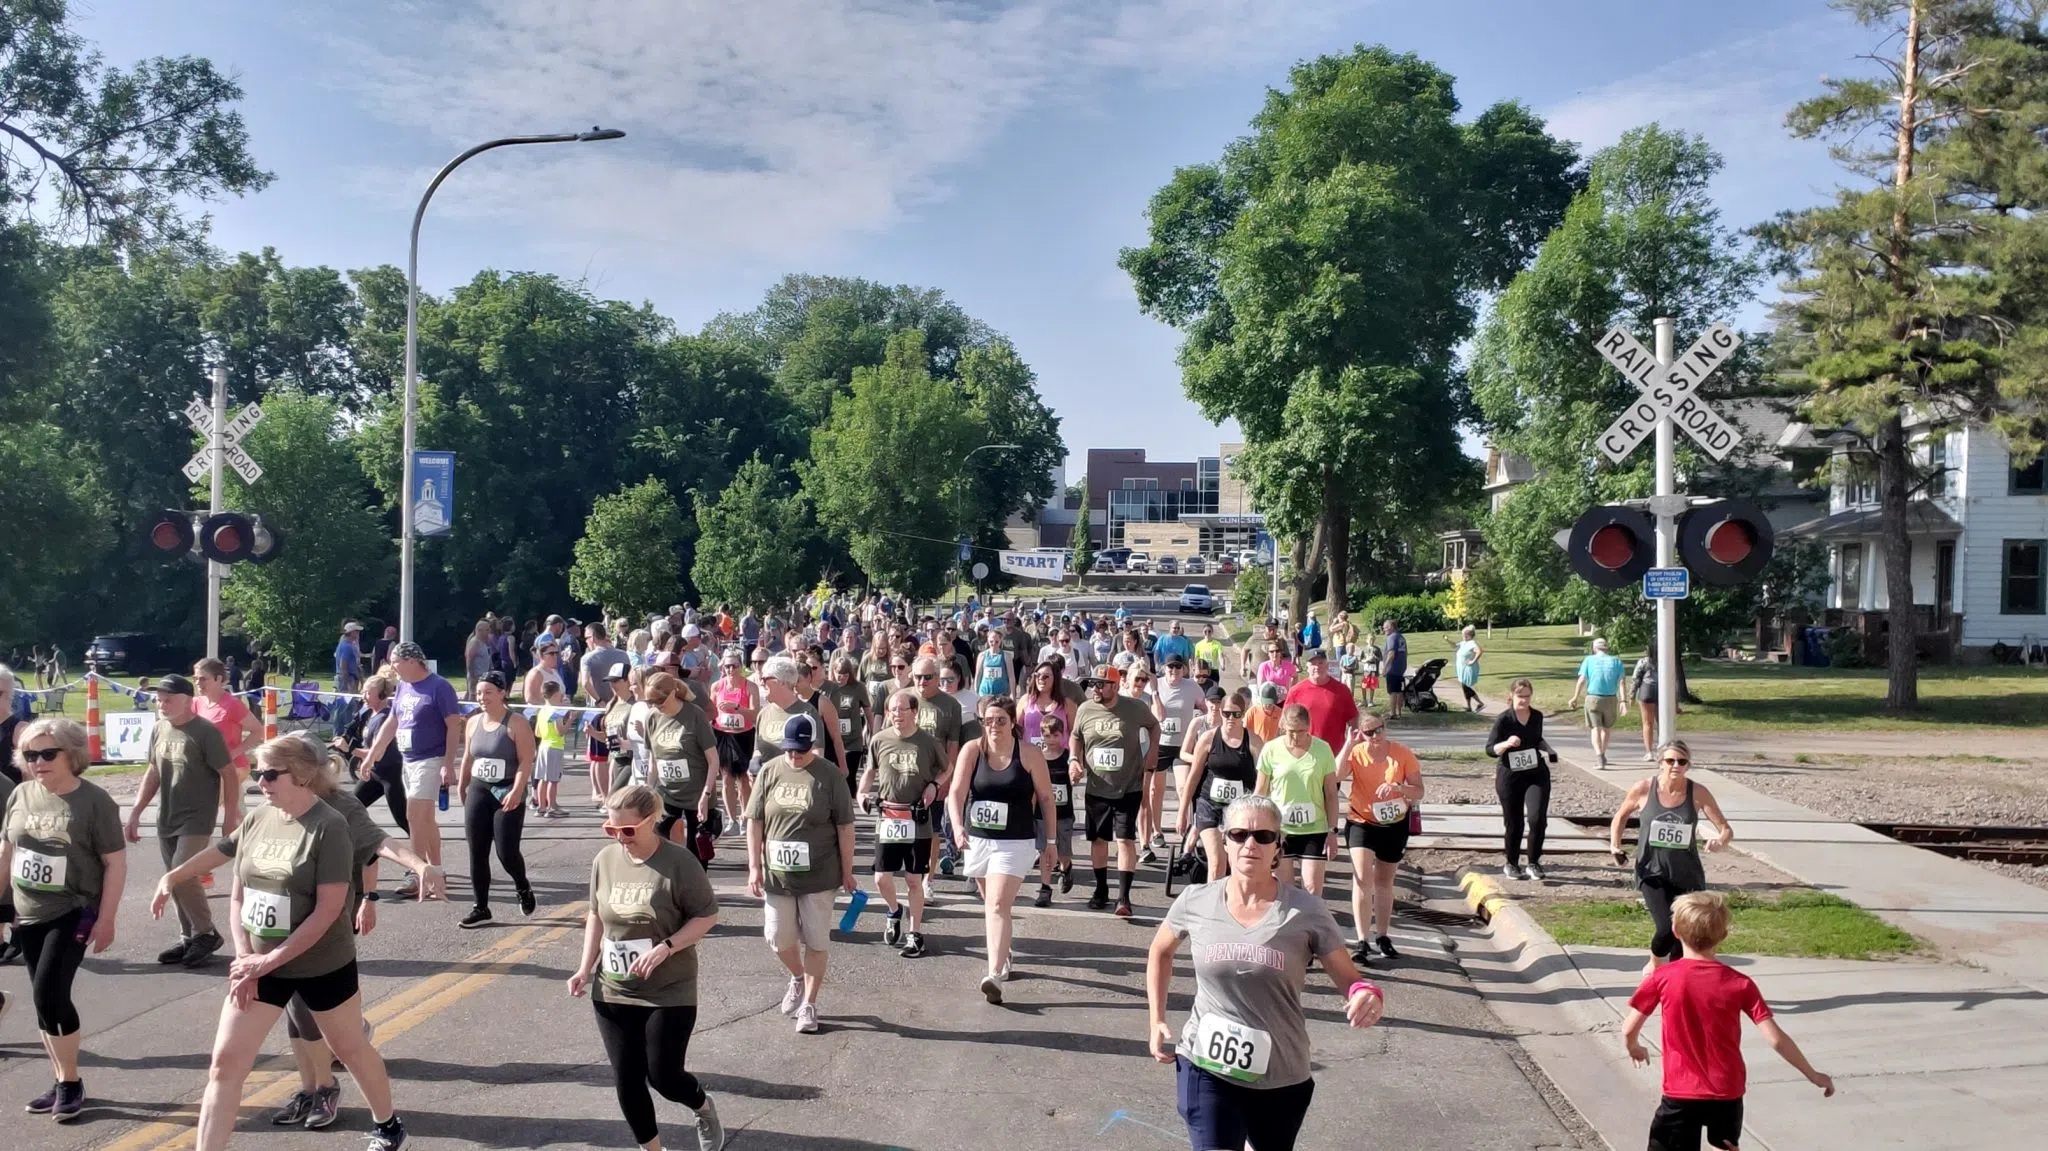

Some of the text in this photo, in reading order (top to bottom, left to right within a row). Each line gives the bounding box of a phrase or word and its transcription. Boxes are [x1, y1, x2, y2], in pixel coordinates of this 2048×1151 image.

[1603, 331, 1731, 451] RAIL ROAD
[1605, 328, 1733, 455] CROSSING
[187, 406, 260, 478] CROSING
[227, 447, 258, 480] ROAD
[419, 457, 449, 465] WELCOME
[1006, 555, 1058, 569] START
[119, 717, 142, 726] FINISH
[1098, 754, 1118, 767] 449
[1514, 754, 1533, 767] 364
[662, 766, 683, 779] 526
[1216, 785, 1238, 800] 569
[976, 808, 999, 825] 594
[1288, 810, 1310, 825] 401
[1380, 804, 1401, 821] 535
[886, 823, 908, 839] 620
[1658, 828, 1684, 844] 656
[776, 849, 801, 867] 402
[22, 859, 53, 884] 638
[607, 887, 653, 905] RUN
[247, 901, 277, 929] 456
[1204, 942, 1285, 972] PENTAGON
[1208, 1030, 1255, 1070] 663
